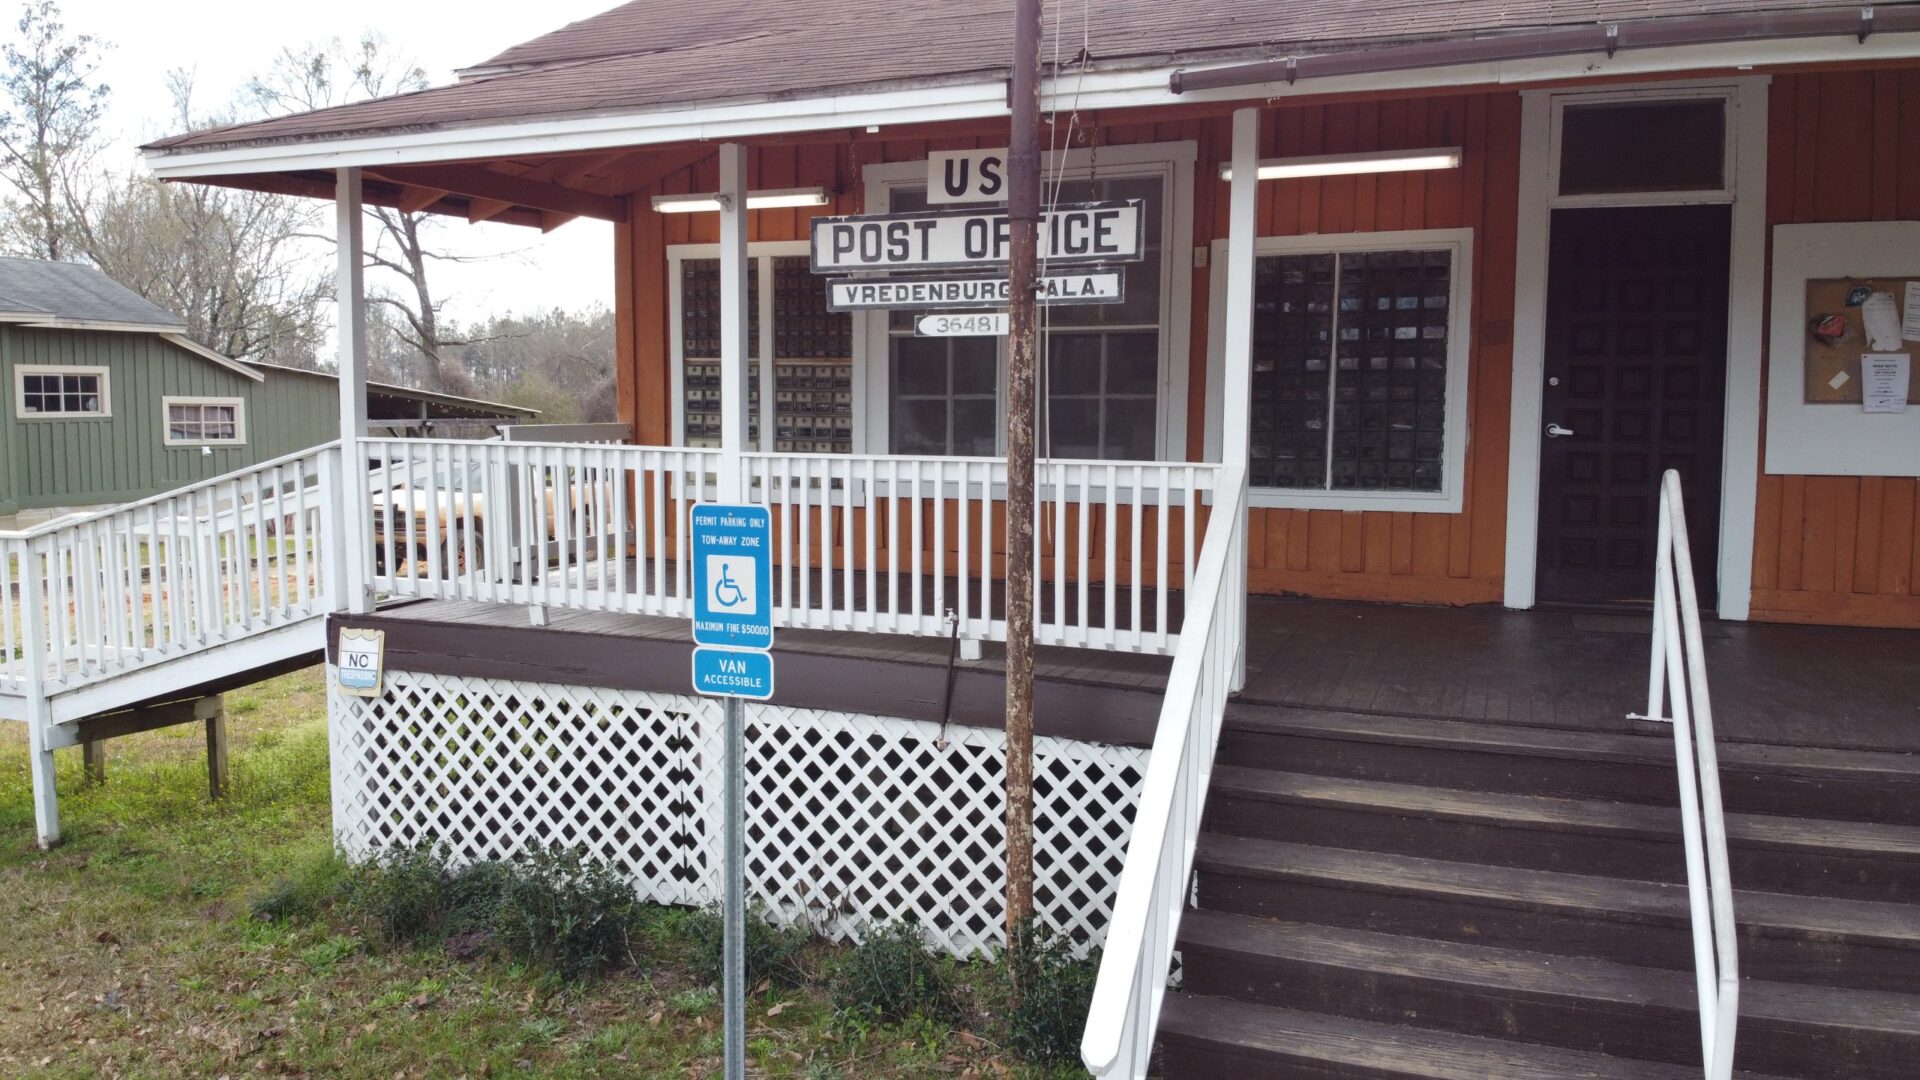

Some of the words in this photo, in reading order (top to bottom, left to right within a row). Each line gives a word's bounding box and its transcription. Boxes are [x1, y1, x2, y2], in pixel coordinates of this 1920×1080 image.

[944, 156, 1002, 197] US
[832, 219, 937, 264] POST
[964, 210, 1120, 259] OFICE
[1047, 277, 1105, 297] ALA.
[936, 316, 1000, 334] 36481
[695, 515, 717, 526] PERMIT
[720, 516, 746, 527] PARKING
[750, 517, 765, 528] ONLY
[702, 534, 737, 546] TOW-AWAY
[741, 536, 760, 547] ZONE
[695, 620, 724, 632] MAXIMUM
[726, 622, 740, 633] FINE
[719, 659, 746, 674] VAN
[704, 674, 762, 688] ACCESSIBLE
